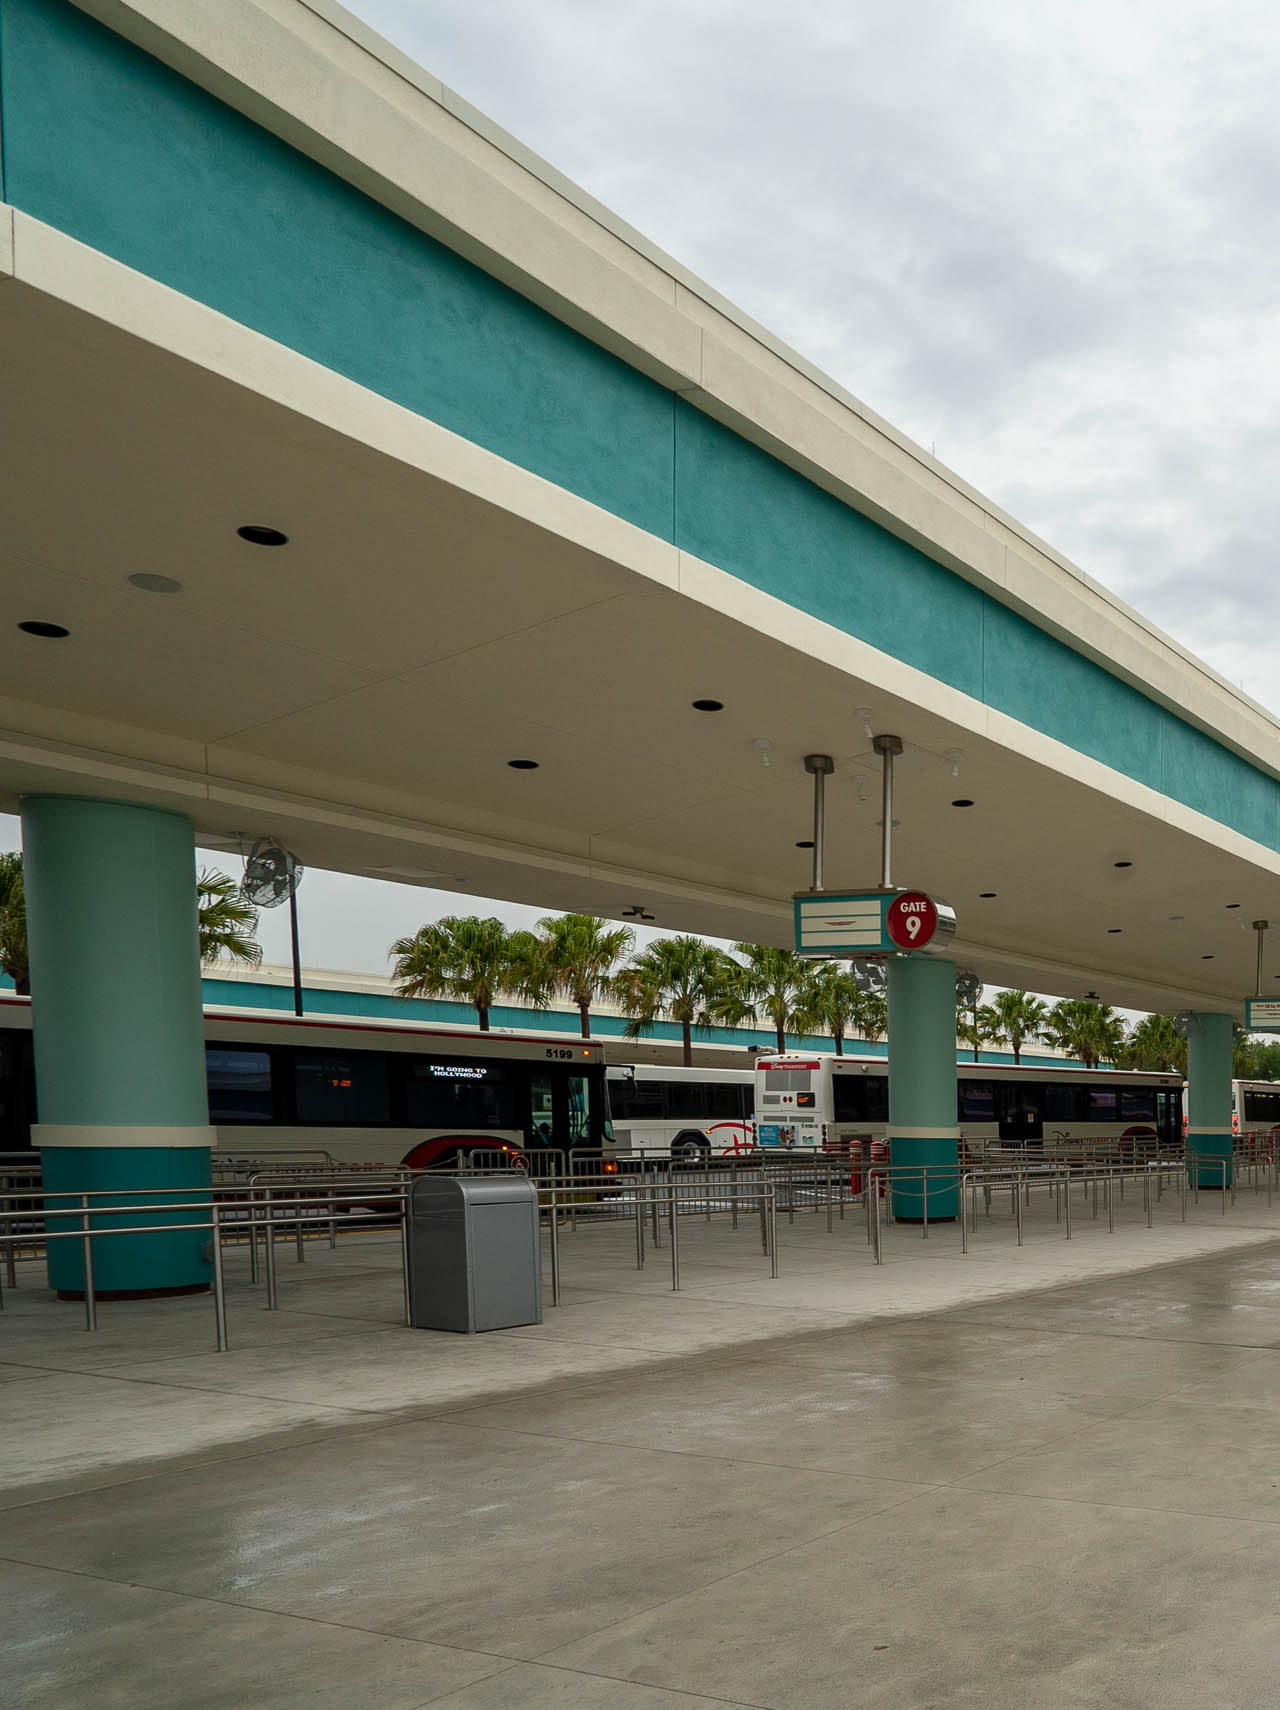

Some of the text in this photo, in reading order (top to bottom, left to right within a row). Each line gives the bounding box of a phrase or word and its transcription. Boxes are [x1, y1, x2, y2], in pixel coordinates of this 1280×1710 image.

[900, 901, 927, 913] GATE
[905, 915, 921, 940] 9
[546, 1049, 572, 1059] 5199
[434, 1071, 483, 1079] HOLLYWOOD
